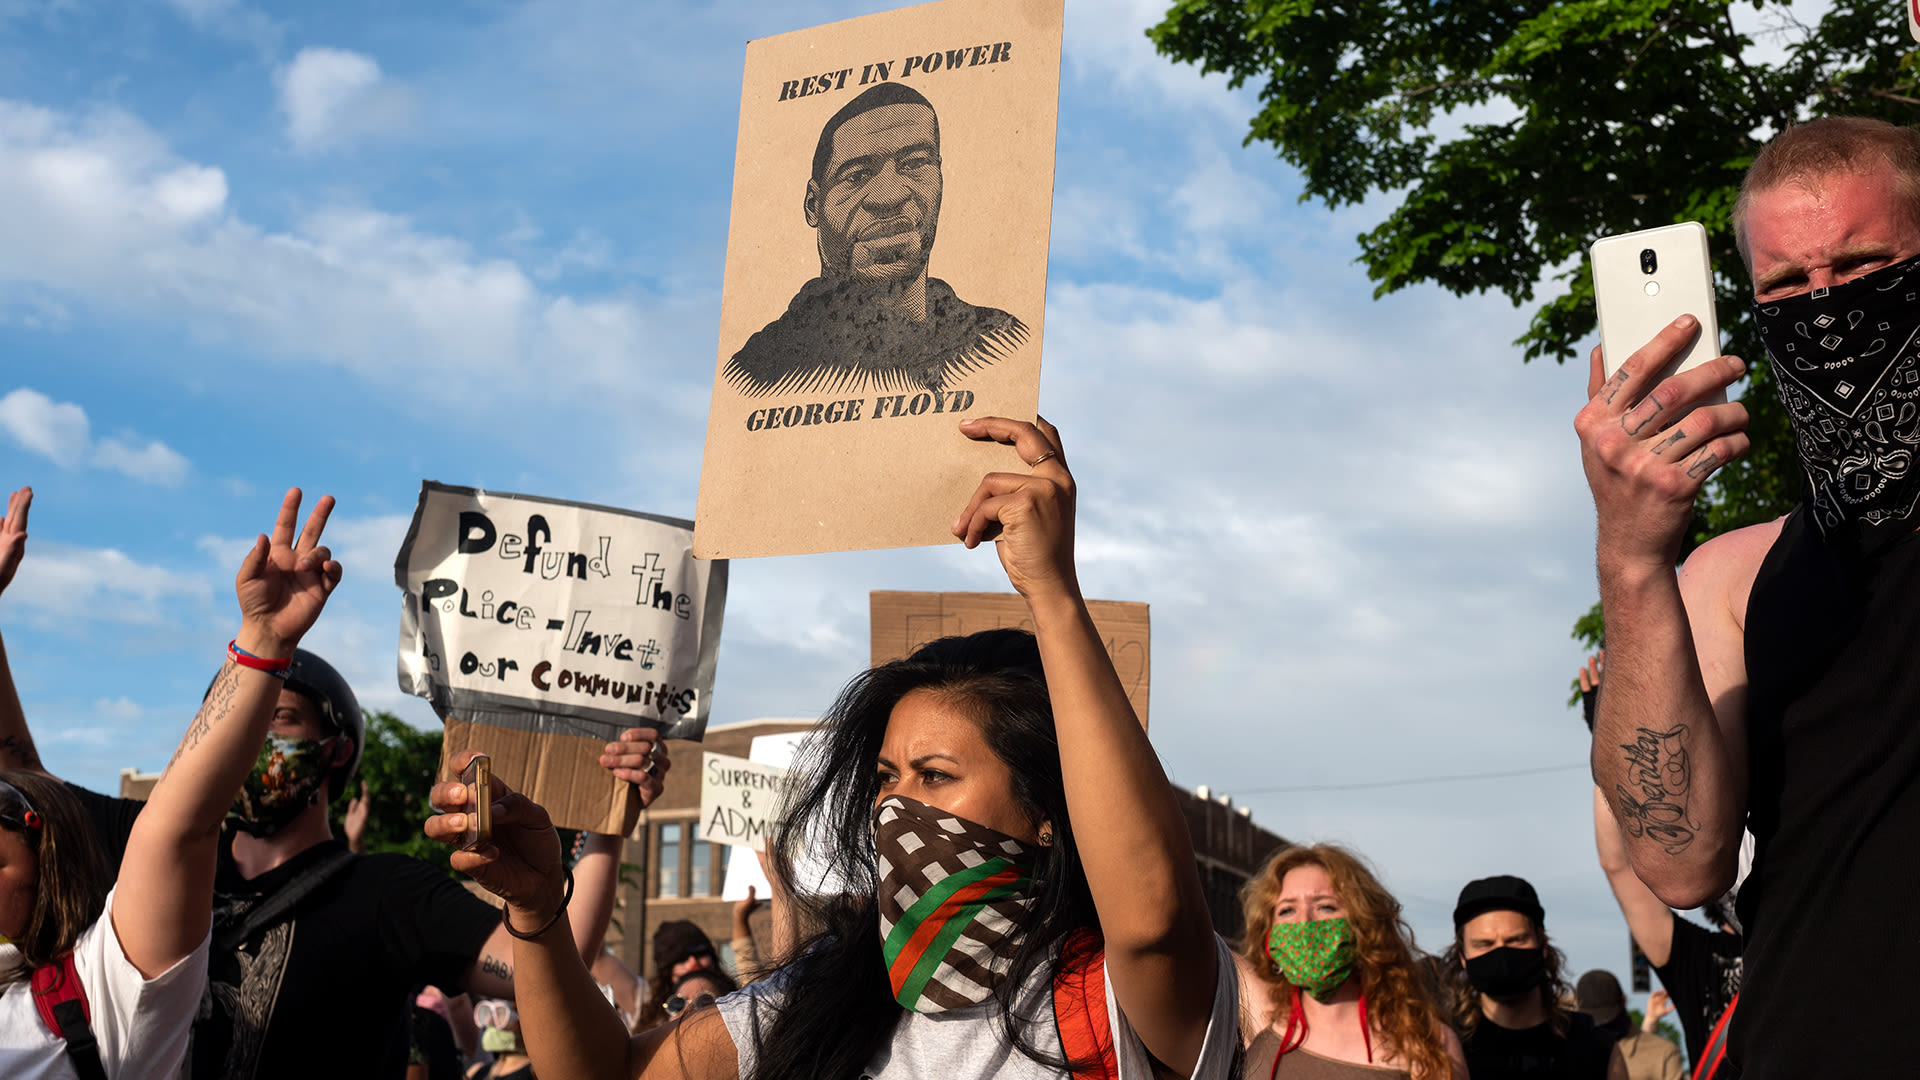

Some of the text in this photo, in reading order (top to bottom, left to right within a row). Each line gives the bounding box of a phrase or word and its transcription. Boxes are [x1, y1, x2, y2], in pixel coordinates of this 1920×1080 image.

[778, 41, 1012, 102] REST IN POWER
[746, 390, 975, 432] GEORGE FLOYD
[458, 511, 691, 619] Defund the
[741, 789, 752, 809] &
